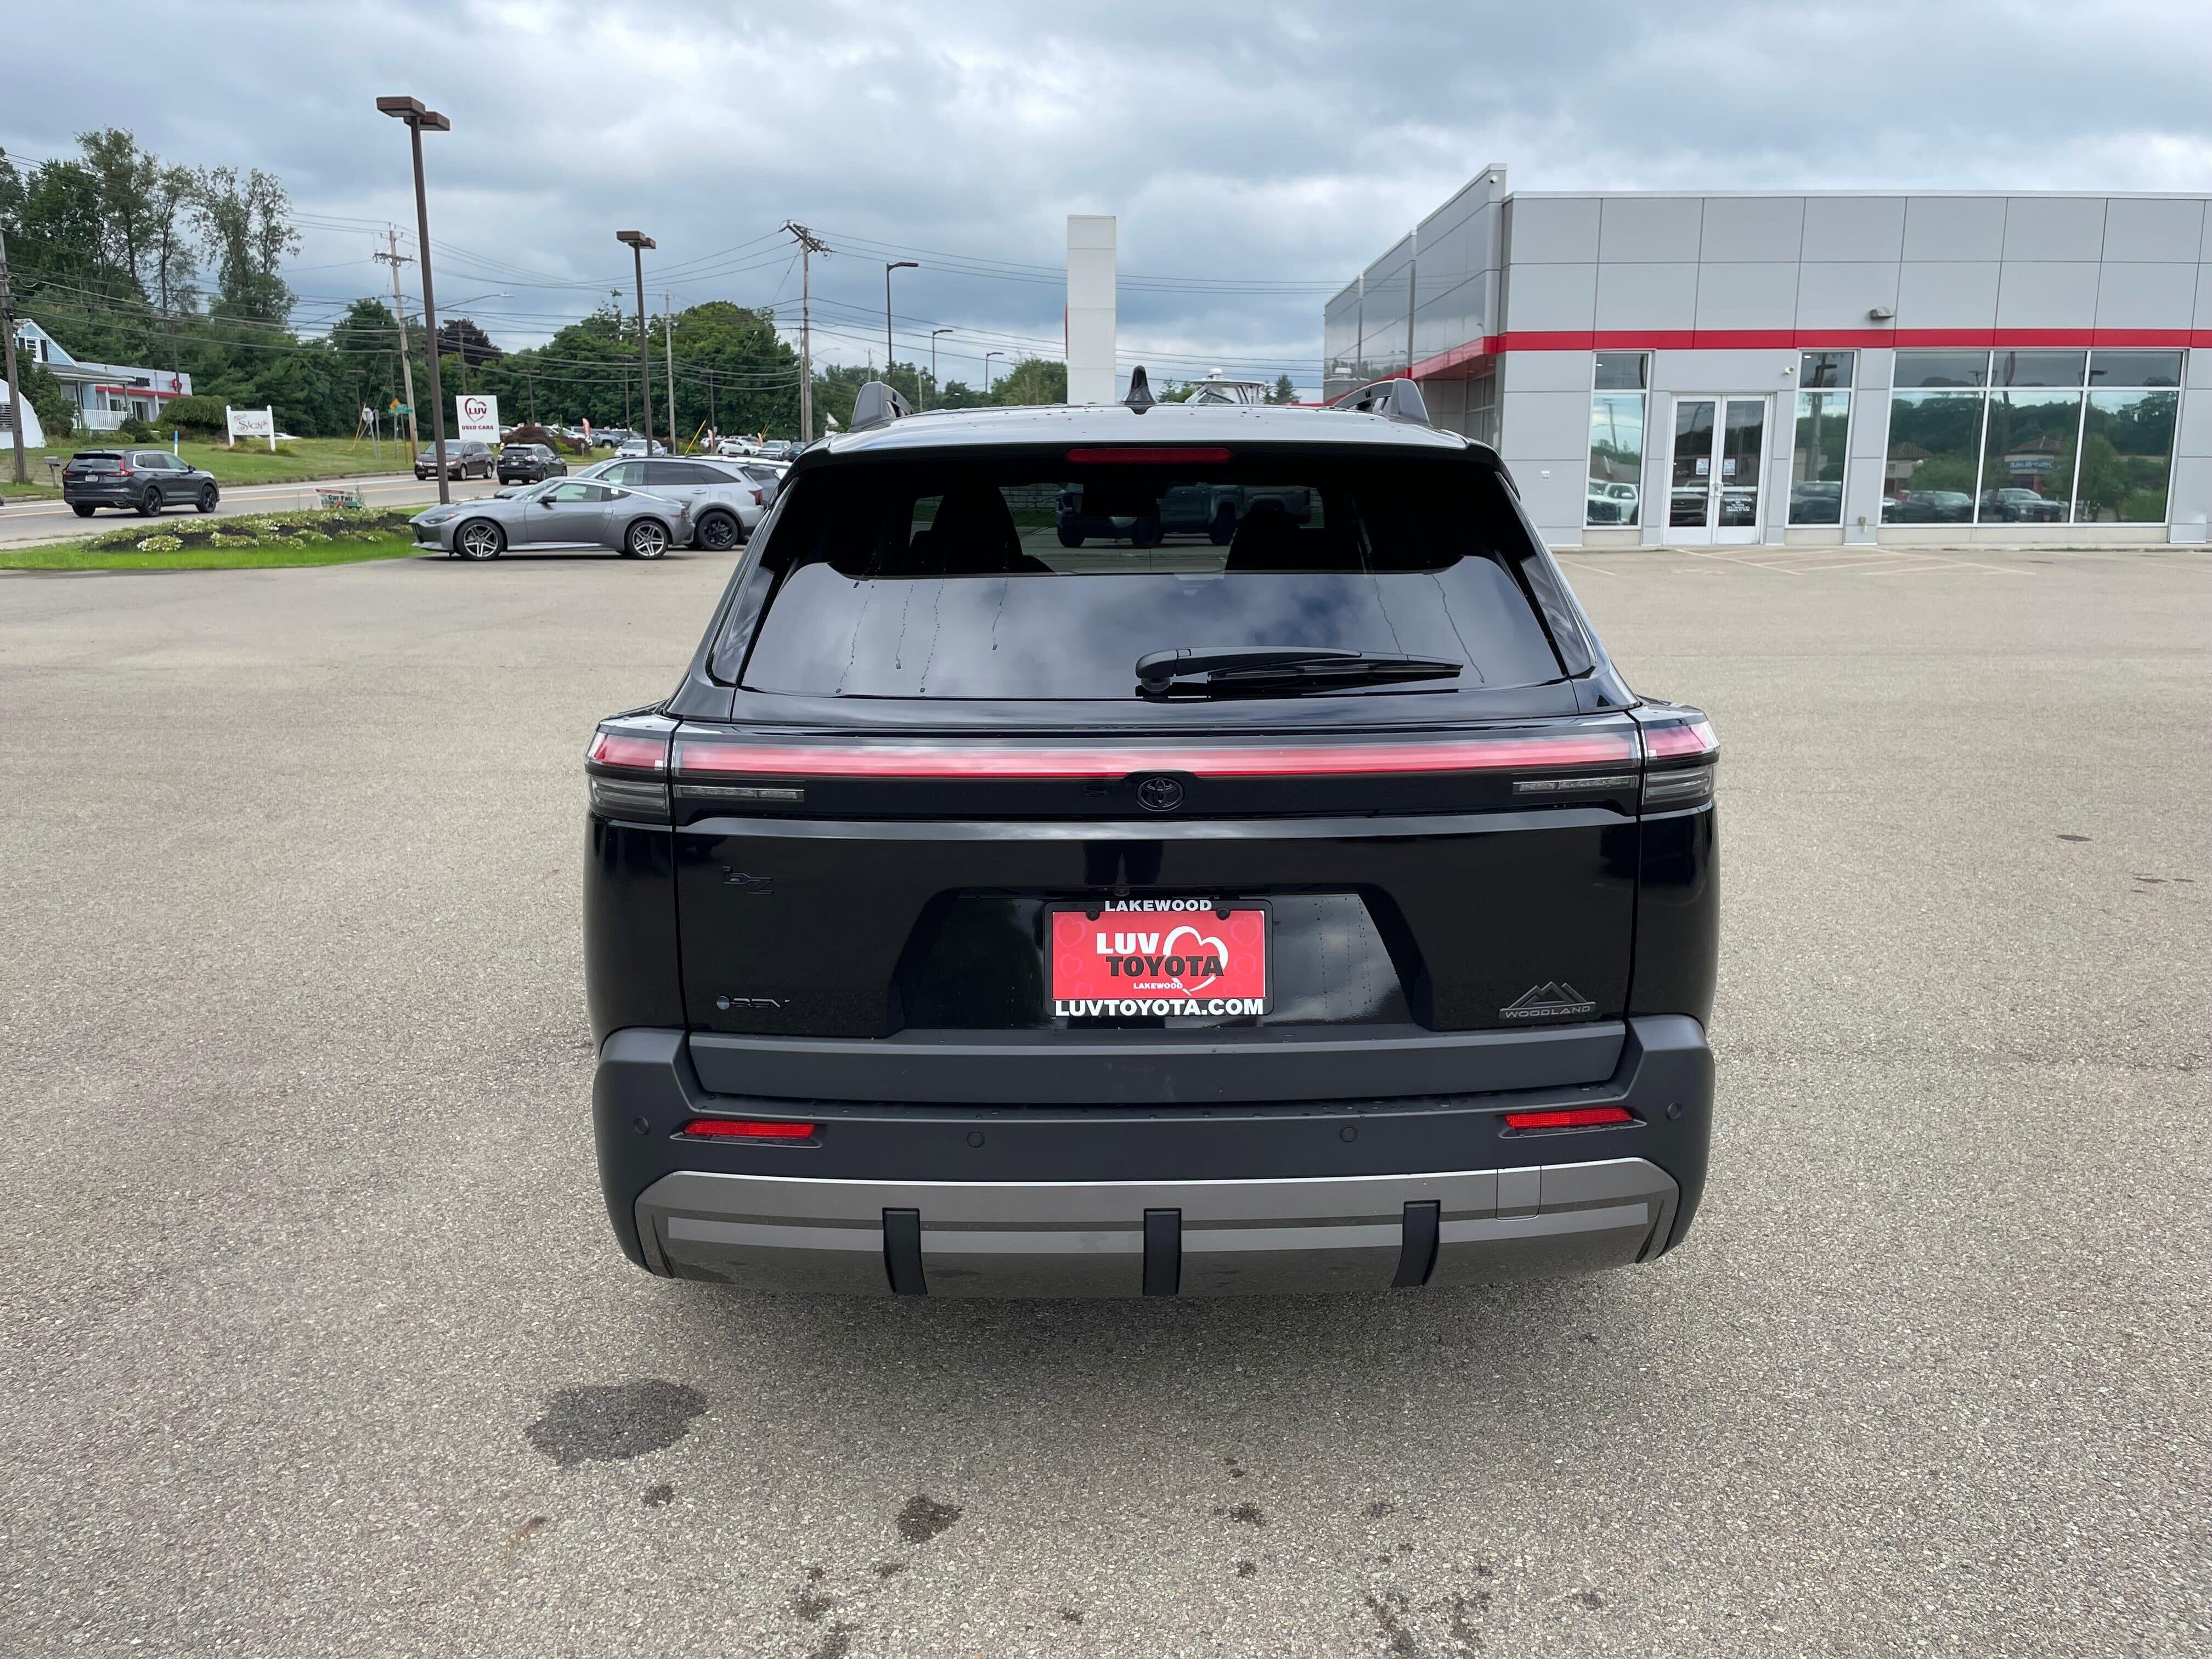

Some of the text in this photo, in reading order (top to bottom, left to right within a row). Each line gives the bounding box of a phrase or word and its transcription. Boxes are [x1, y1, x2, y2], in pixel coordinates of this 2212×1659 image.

[1105, 900, 1212, 912] LAKEWOOD
[1097, 933, 1160, 955] LUV
[1106, 956, 1224, 977] TOYOTA
[1055, 998, 1263, 1016] LUVTOYOTA.COM
[1505, 1006, 1591, 1018] WOODLAND
